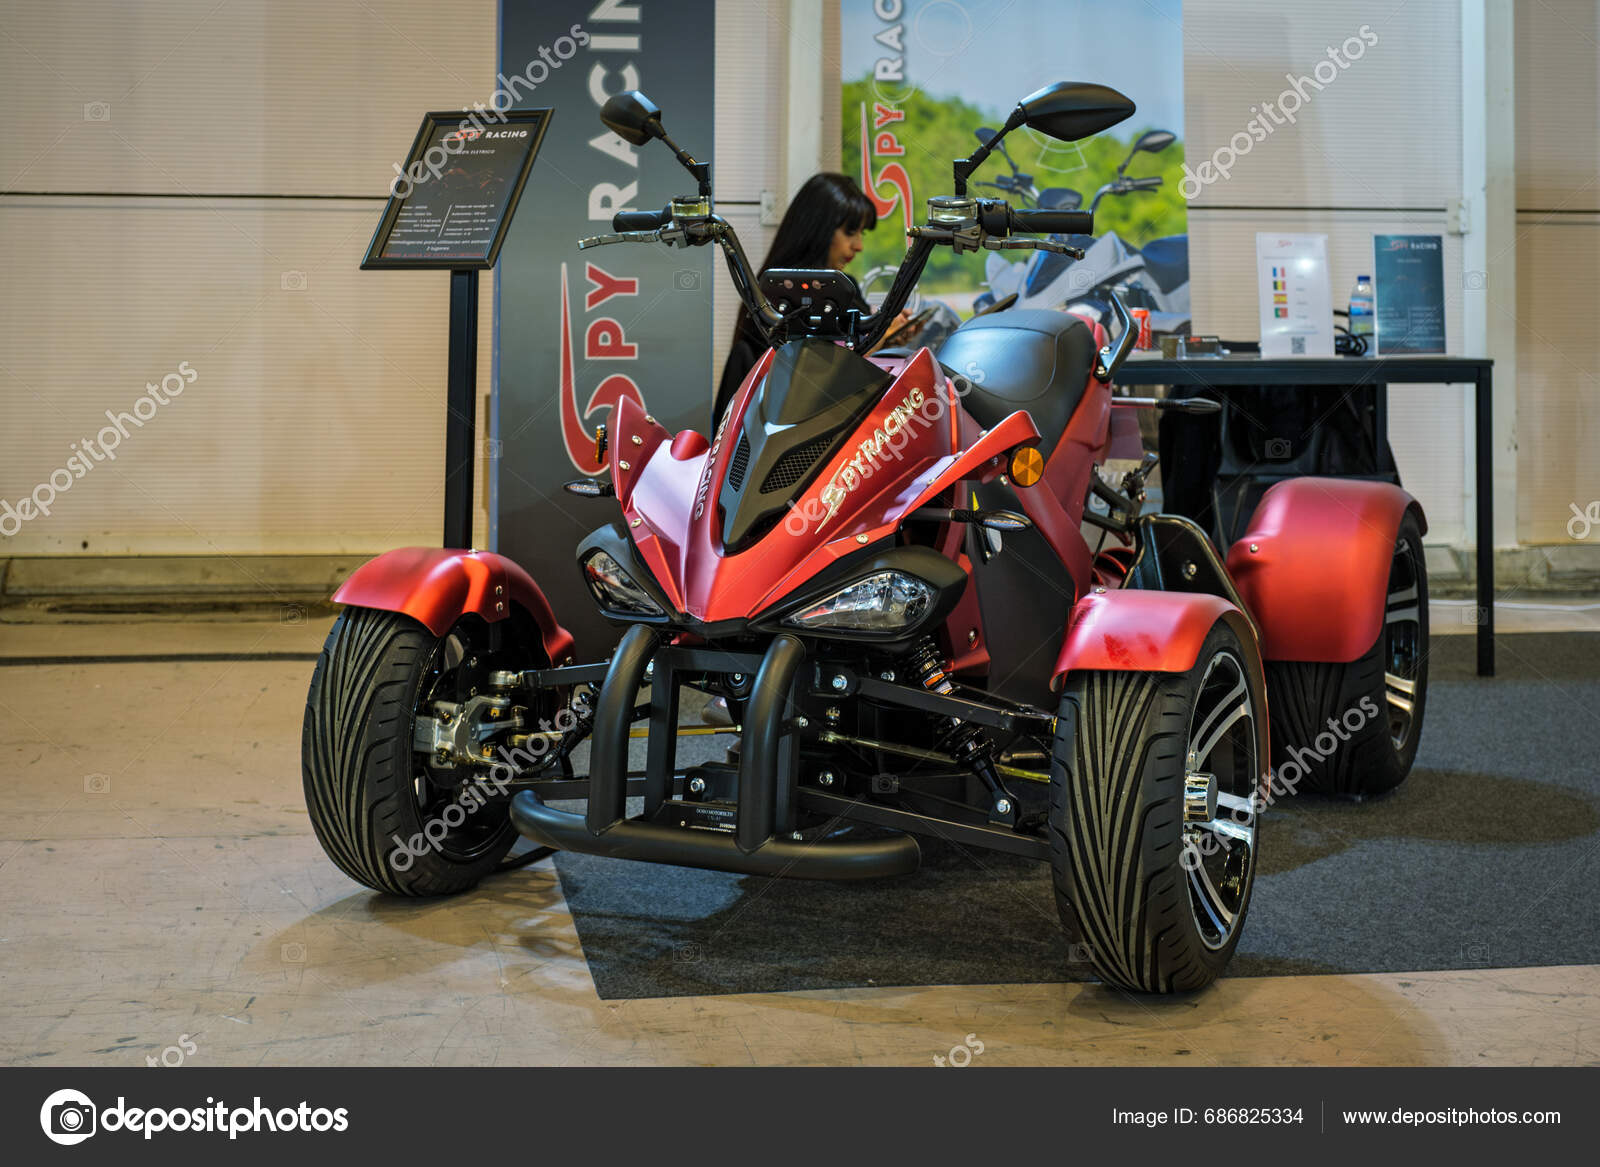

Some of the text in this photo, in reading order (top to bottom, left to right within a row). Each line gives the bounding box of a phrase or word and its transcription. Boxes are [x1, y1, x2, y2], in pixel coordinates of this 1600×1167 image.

[485, 130, 528, 139] RACING
[861, 101, 914, 252] SPY
[559, 261, 648, 476] SPY
[860, 387, 925, 462] RACING
